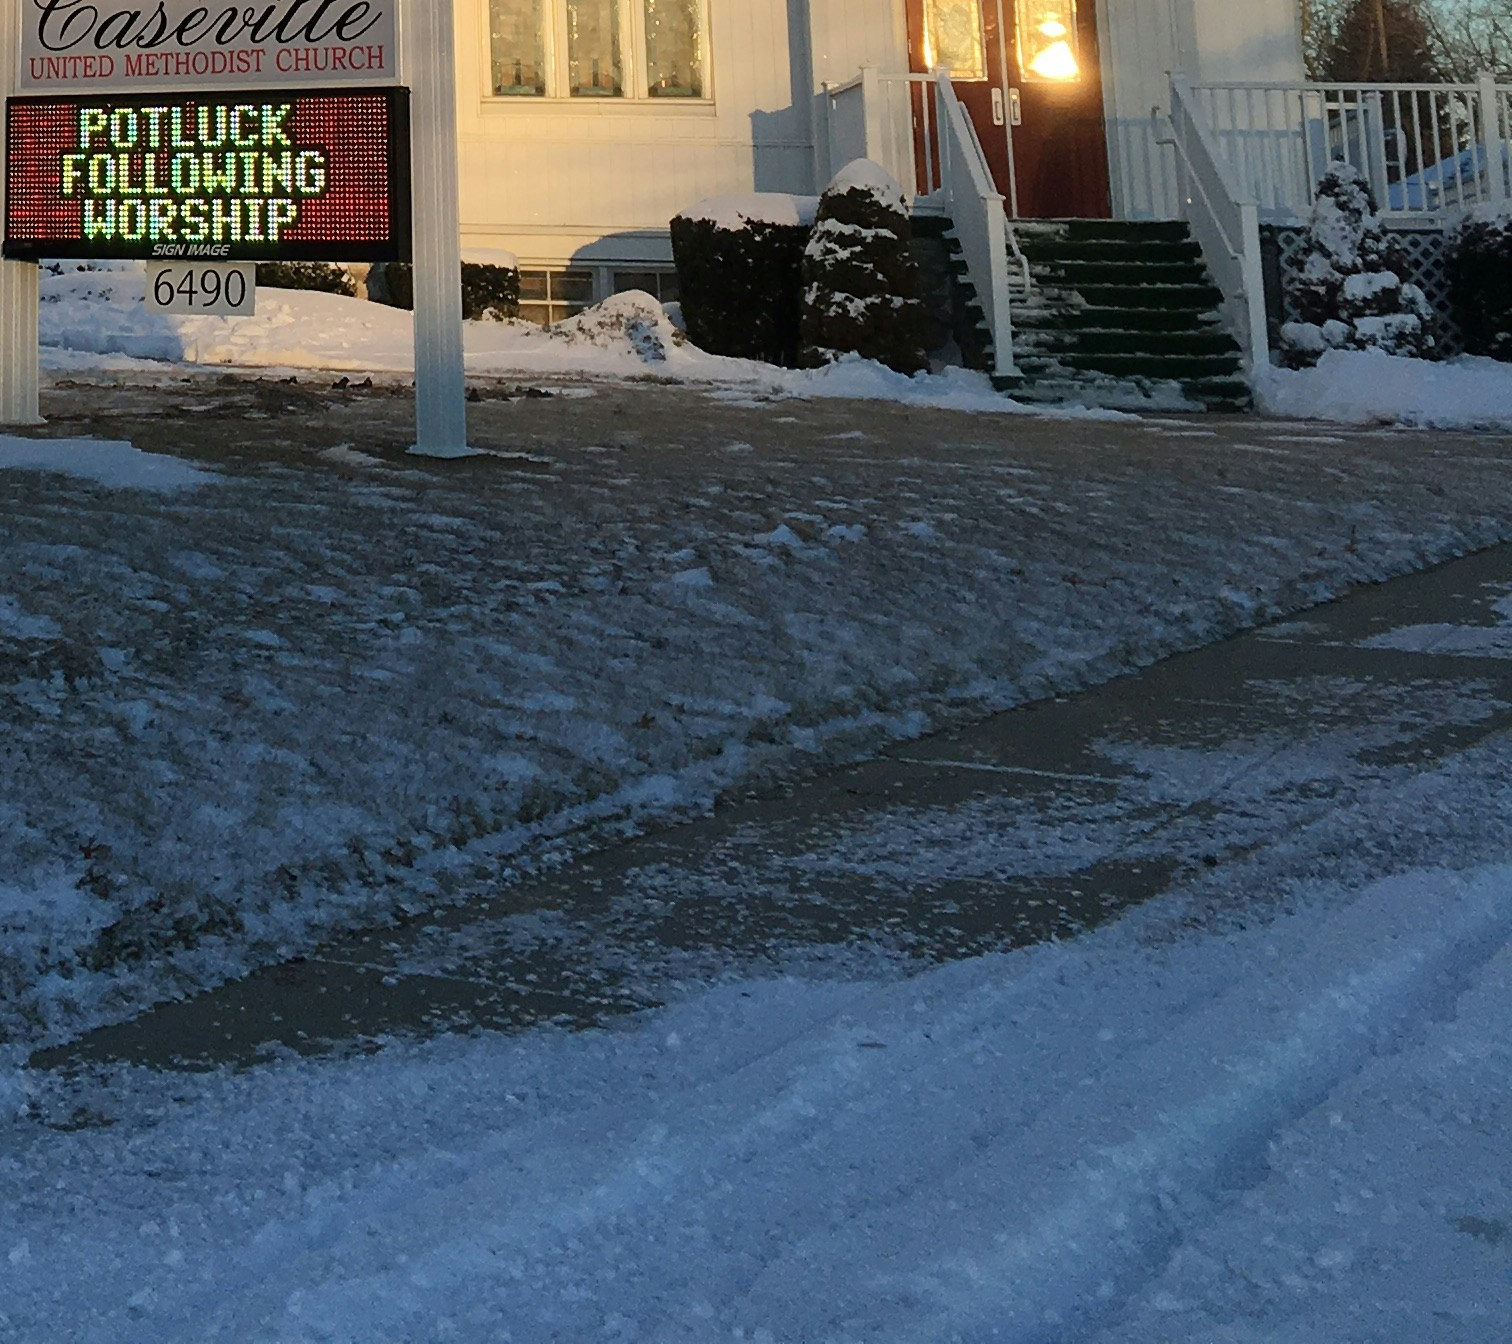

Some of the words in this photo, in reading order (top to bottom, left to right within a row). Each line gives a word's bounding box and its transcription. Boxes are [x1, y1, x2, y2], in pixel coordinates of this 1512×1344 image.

[29, 55, 115, 80] UNITED
[124, 48, 266, 77] METHODIST
[275, 45, 385, 72] CHURCH
[79, 104, 292, 149] POTLUCK
[61, 150, 326, 196] FOLLOWING
[82, 198, 298, 242] WORSHIP
[151, 243, 186, 256] SIGN
[186, 244, 231, 256] IMAGE
[153, 268, 247, 308] 6490
